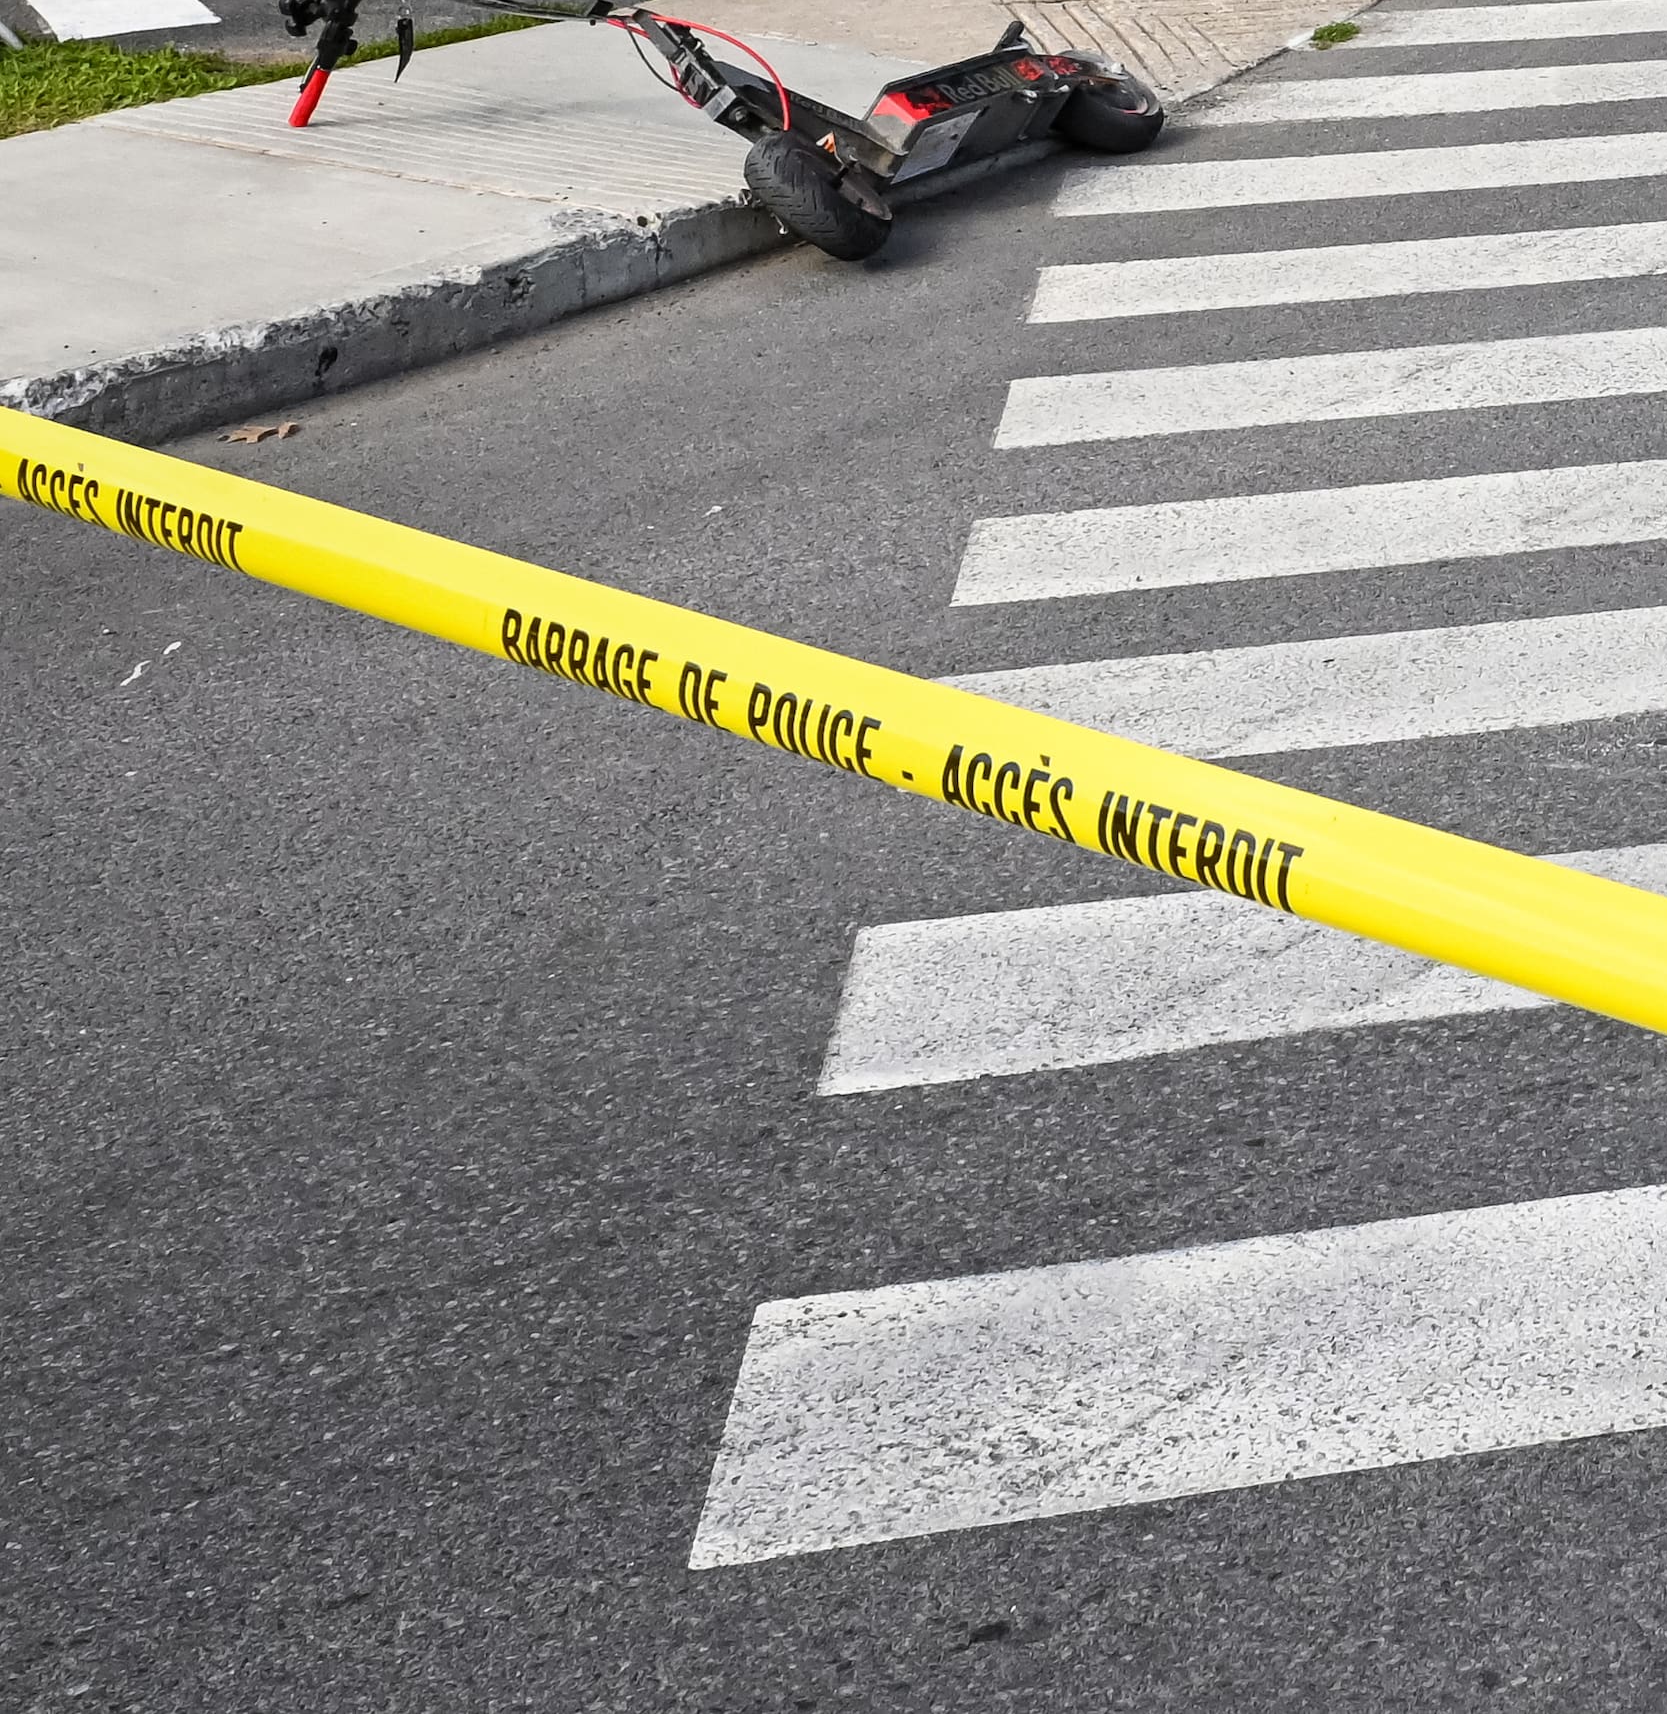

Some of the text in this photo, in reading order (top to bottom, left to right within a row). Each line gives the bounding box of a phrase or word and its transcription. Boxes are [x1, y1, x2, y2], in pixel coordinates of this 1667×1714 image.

[16, 458, 246, 574] ACCÈS INTERDIT
[500, 607, 660, 711] BARRAGE
[678, 659, 727, 730] DE
[746, 680, 883, 781] POLICE
[940, 742, 1075, 845] ACCÈS
[1096, 788, 1305, 916] INTERDIT
